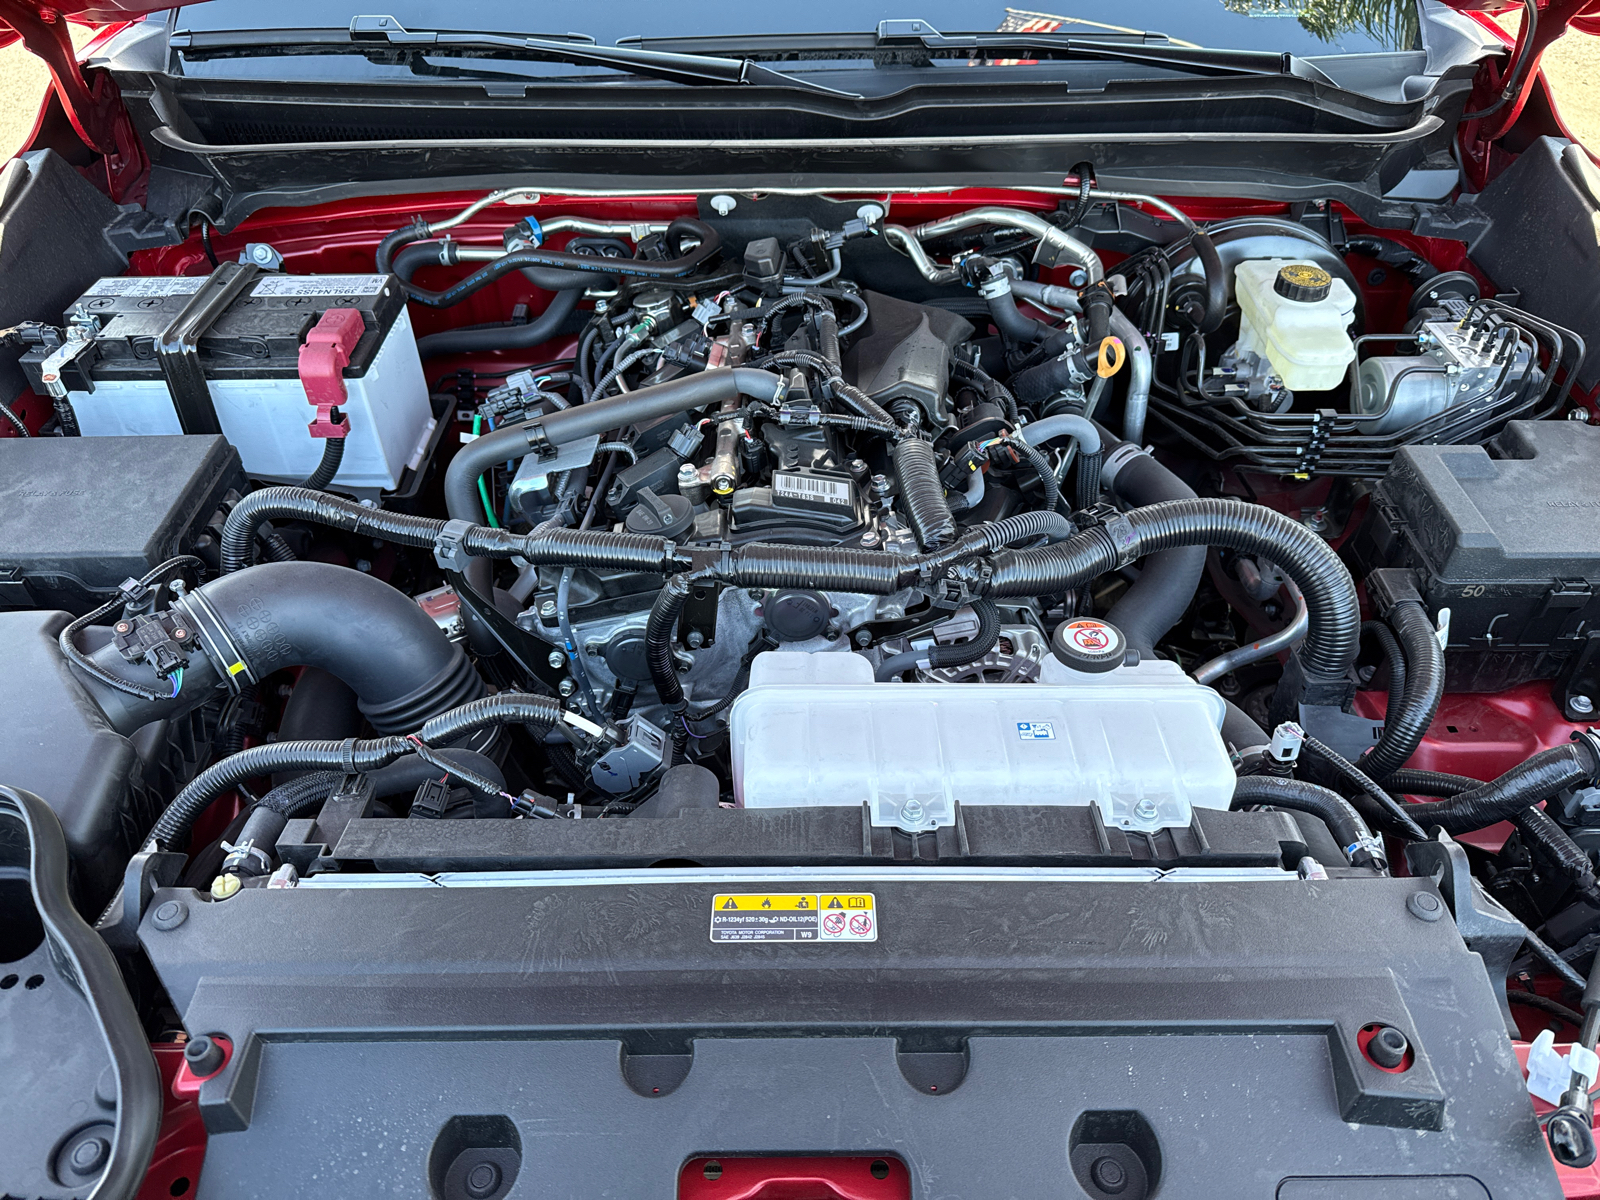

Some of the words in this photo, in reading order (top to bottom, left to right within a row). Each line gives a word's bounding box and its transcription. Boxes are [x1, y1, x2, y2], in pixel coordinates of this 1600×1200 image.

[1461, 584, 1486, 598] 50
[722, 916, 745, 924] R-1234yf
[800, 931, 813, 939] W9
